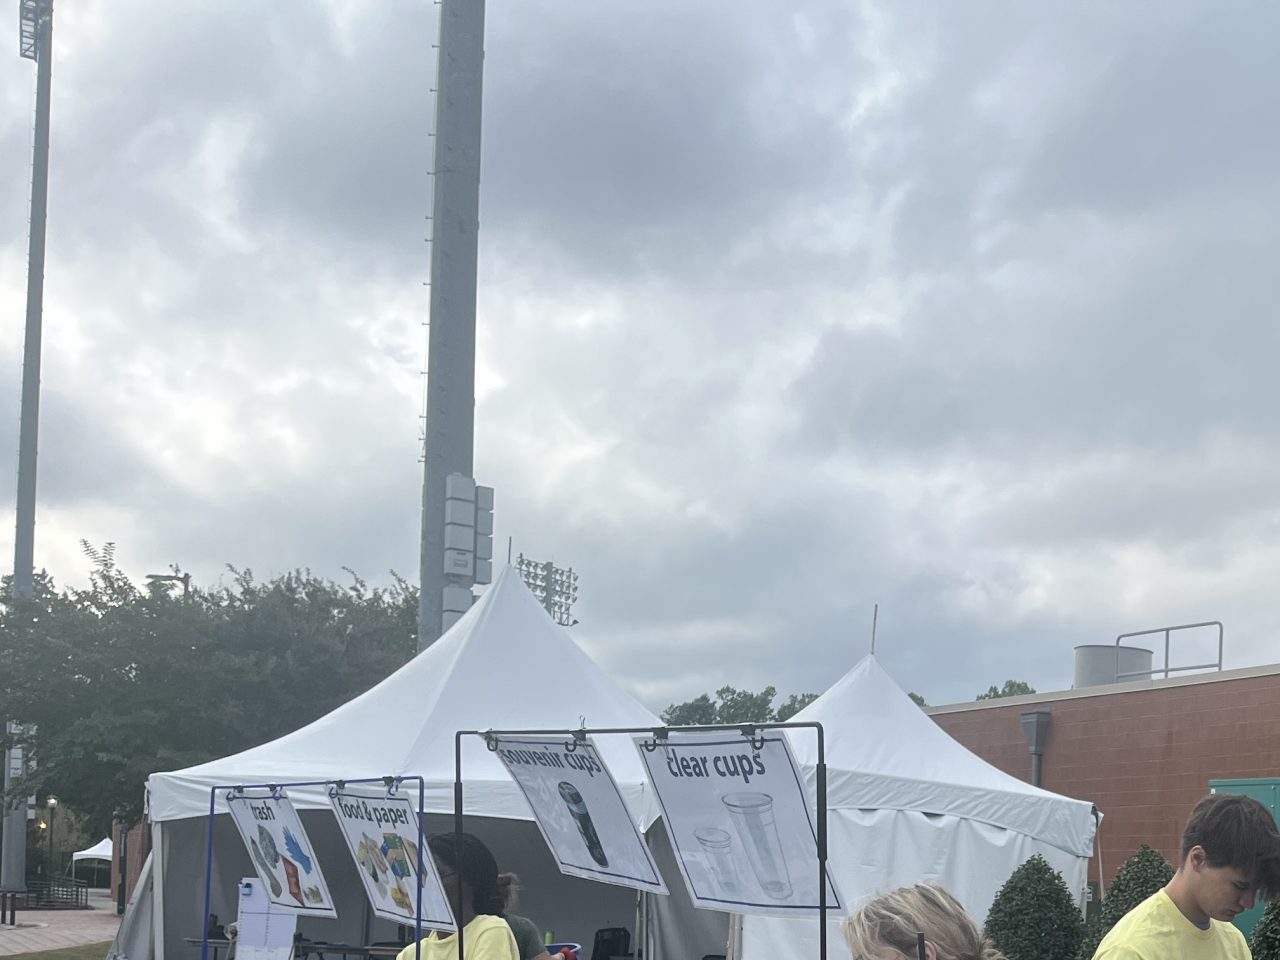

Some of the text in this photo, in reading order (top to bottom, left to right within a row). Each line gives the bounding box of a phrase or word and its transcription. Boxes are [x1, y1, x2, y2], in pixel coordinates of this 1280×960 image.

[503, 746, 601, 777] souvenir cups
[667, 749, 766, 783] clear cups
[250, 801, 275, 820] trash
[338, 797, 409, 829] food & paper
